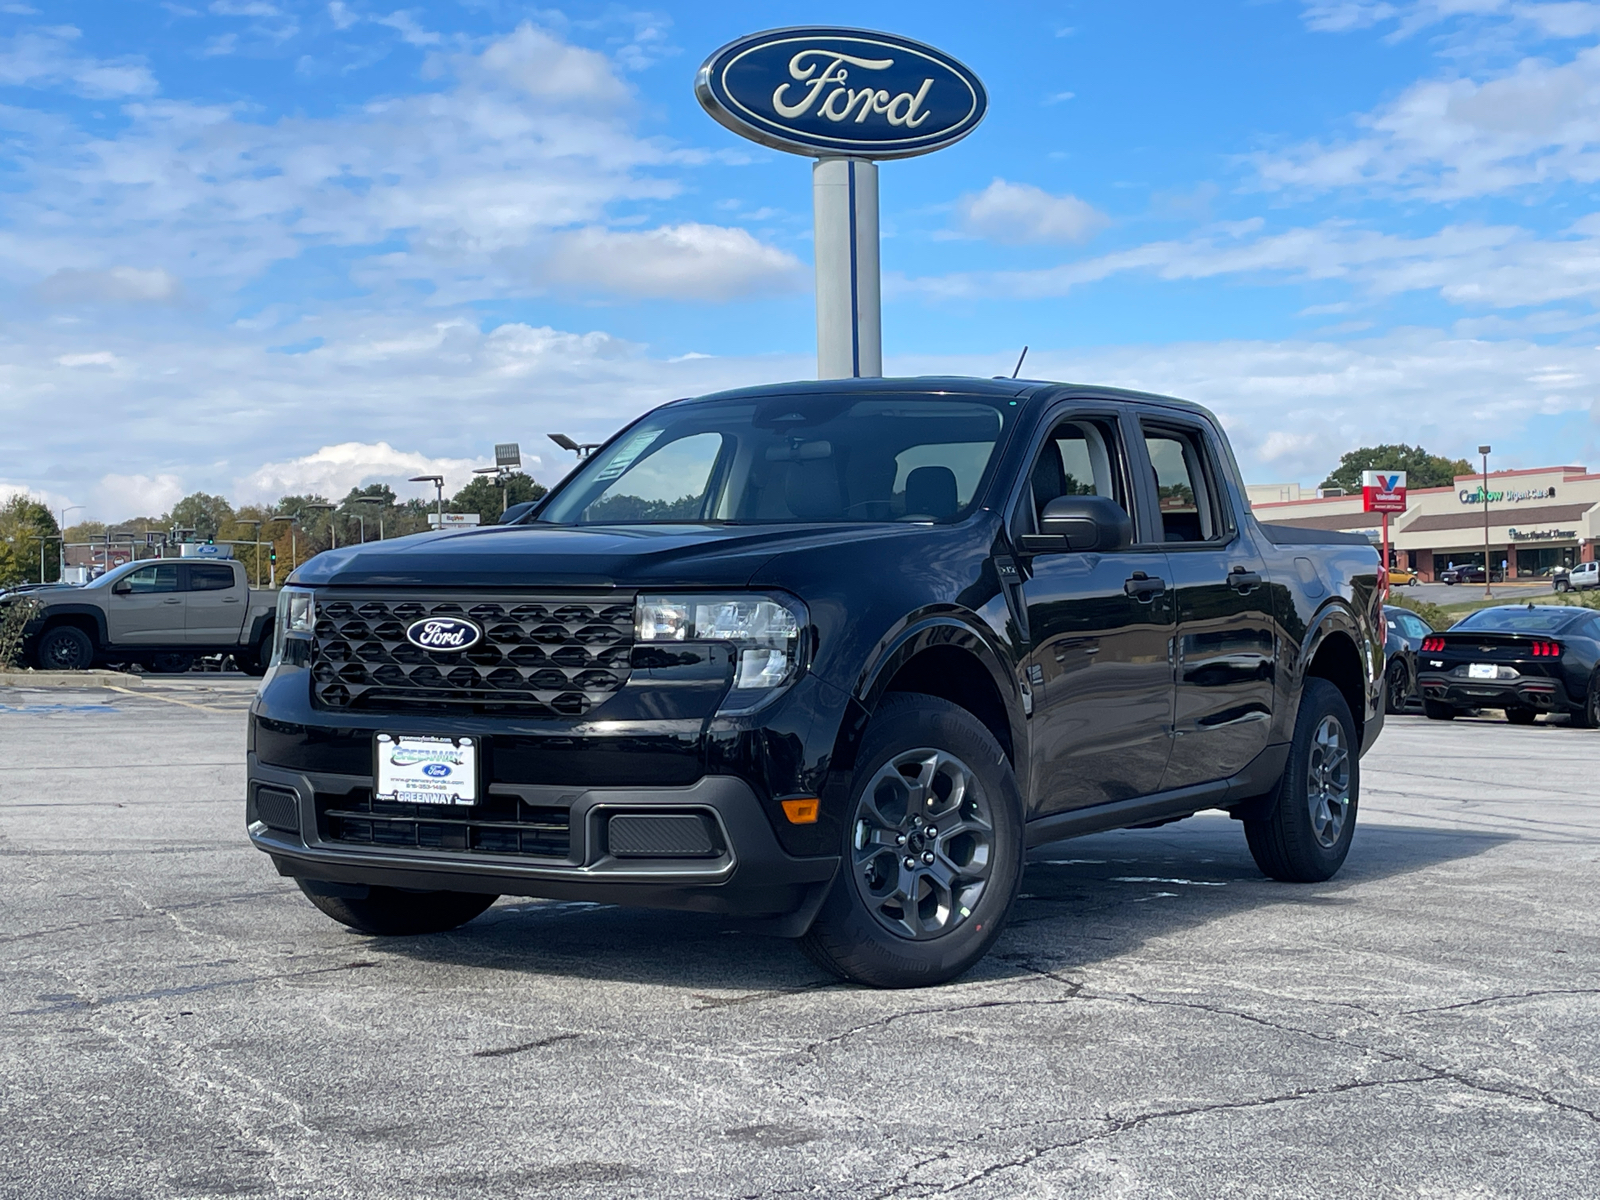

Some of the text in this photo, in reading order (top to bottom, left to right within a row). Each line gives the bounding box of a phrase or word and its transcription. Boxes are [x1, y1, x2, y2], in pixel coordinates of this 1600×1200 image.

[772, 49, 935, 129] Ford
[1506, 490, 1530, 503] Urgent
[1532, 489, 1549, 499] Care
[419, 621, 466, 646] Ford
[427, 765, 447, 776] Ford
[397, 791, 452, 804] GREENWAY
